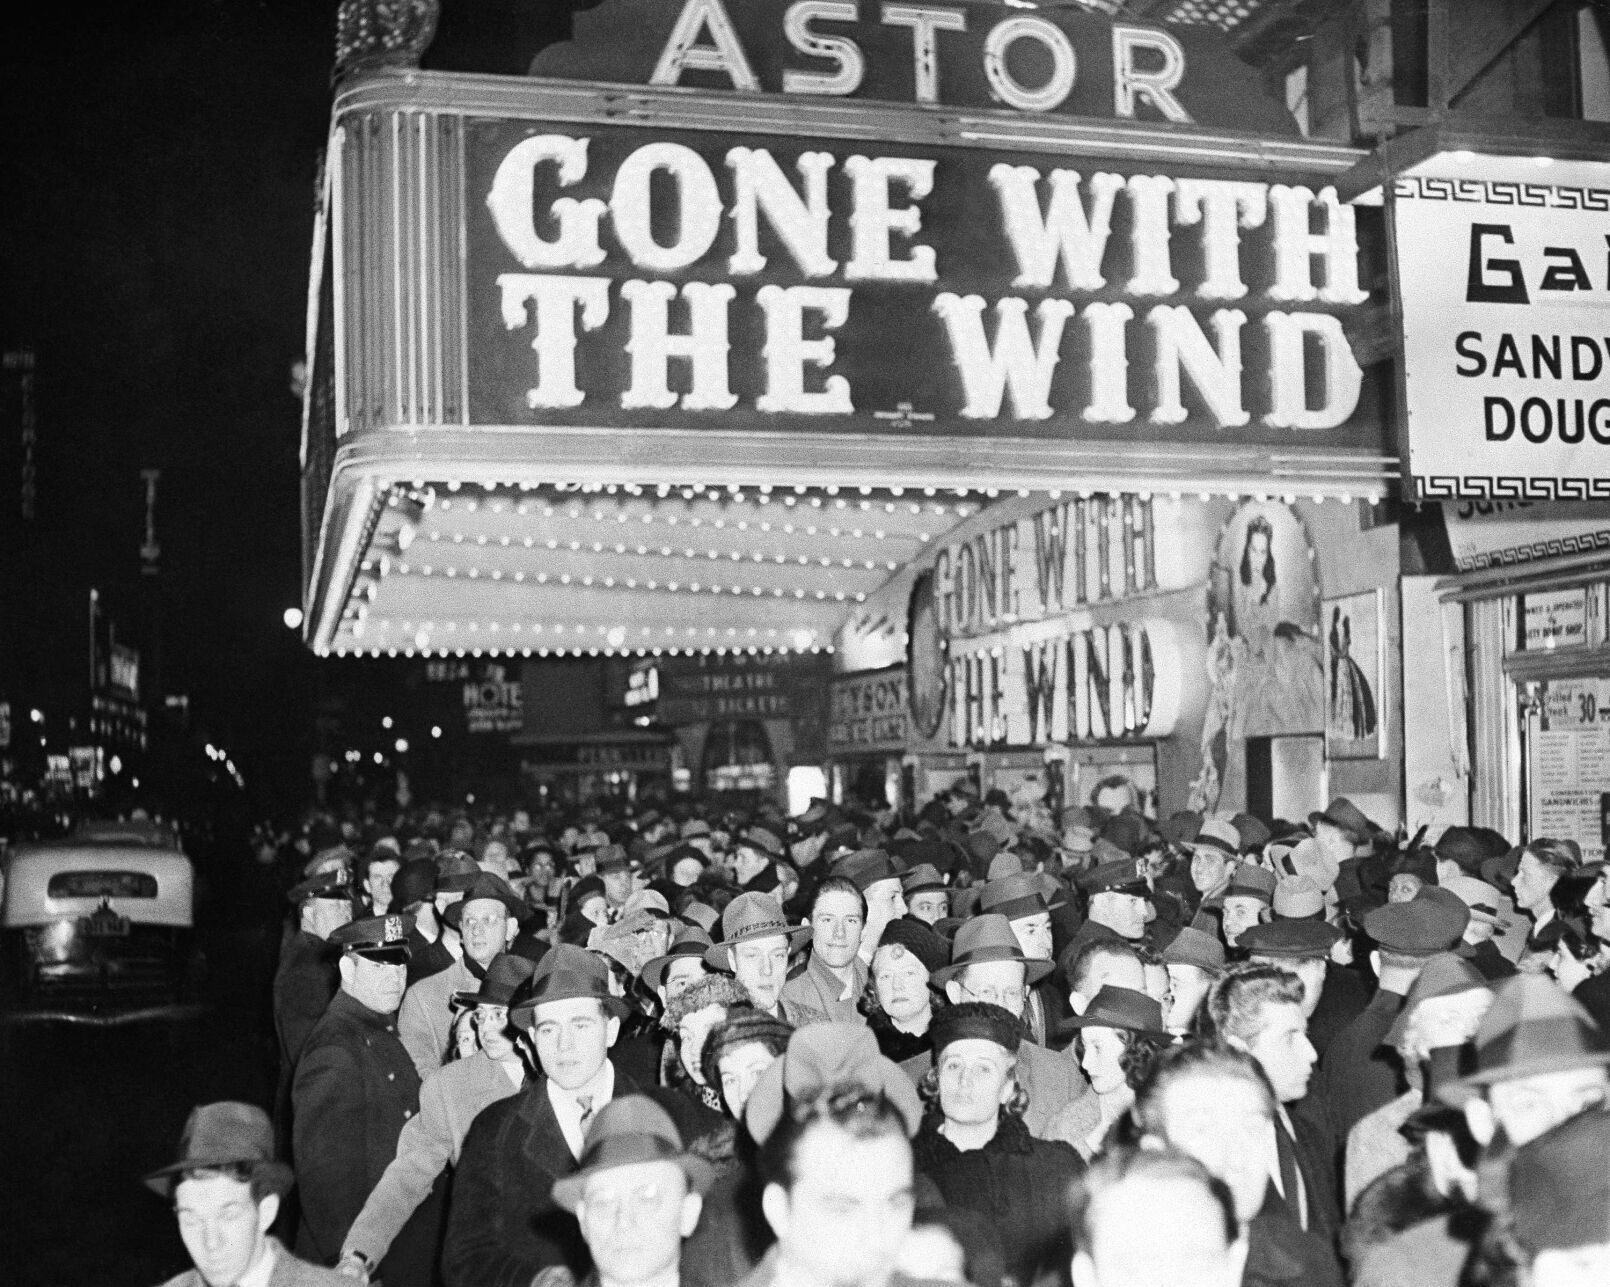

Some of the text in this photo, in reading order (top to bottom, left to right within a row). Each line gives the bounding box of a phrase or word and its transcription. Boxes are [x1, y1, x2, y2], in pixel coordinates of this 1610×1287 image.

[648, 0, 1193, 122] ASTOR
[486, 134, 1370, 303] GONE WITH
[1465, 223, 1610, 304] Ga
[496, 273, 1364, 430] THE WIND
[1455, 330, 1610, 382] SAND
[933, 492, 1159, 638] GONE WITH
[944, 622, 1156, 746] THE WIND
[1577, 692, 1597, 724] 30
